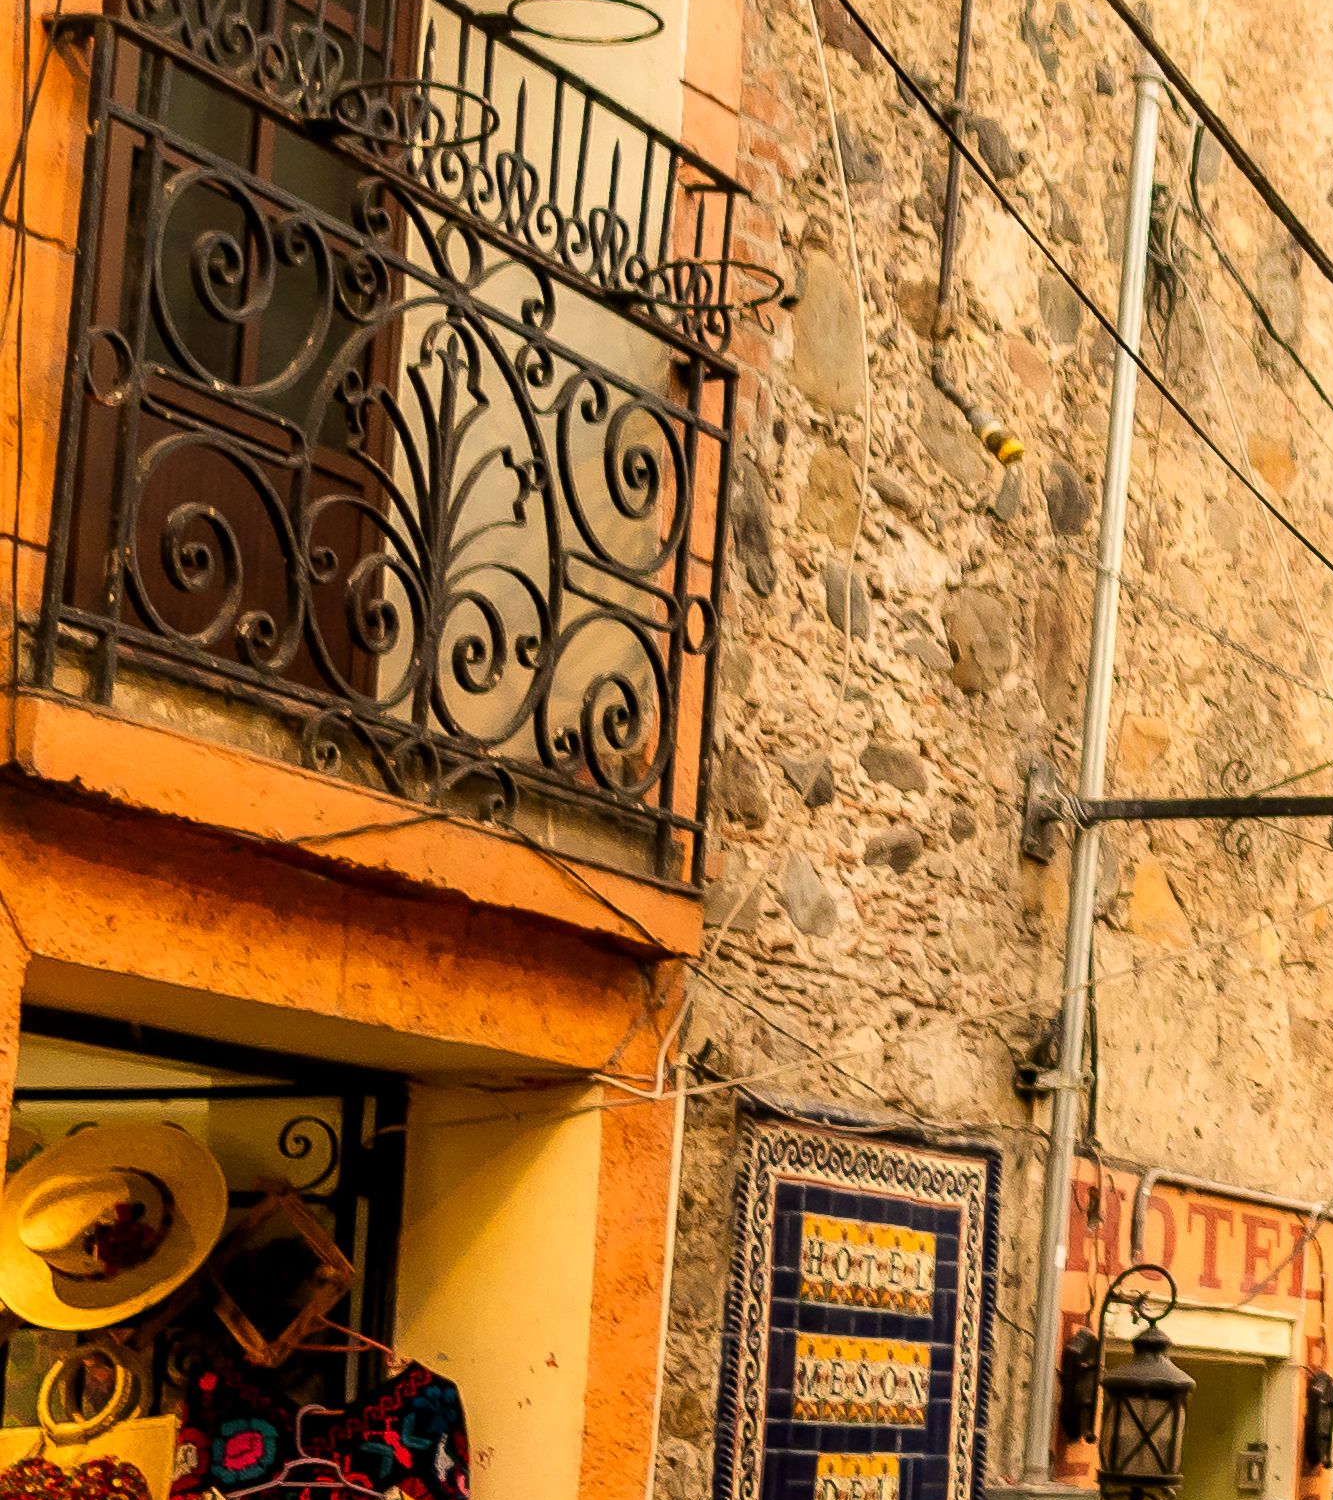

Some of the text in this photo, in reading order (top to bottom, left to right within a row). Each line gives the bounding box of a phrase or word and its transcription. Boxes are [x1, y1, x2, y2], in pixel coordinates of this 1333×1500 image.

[805, 1238, 930, 1292] HOTEL
[1065, 1180, 1324, 1301] HOTEL
[799, 1359, 927, 1402] MESON
